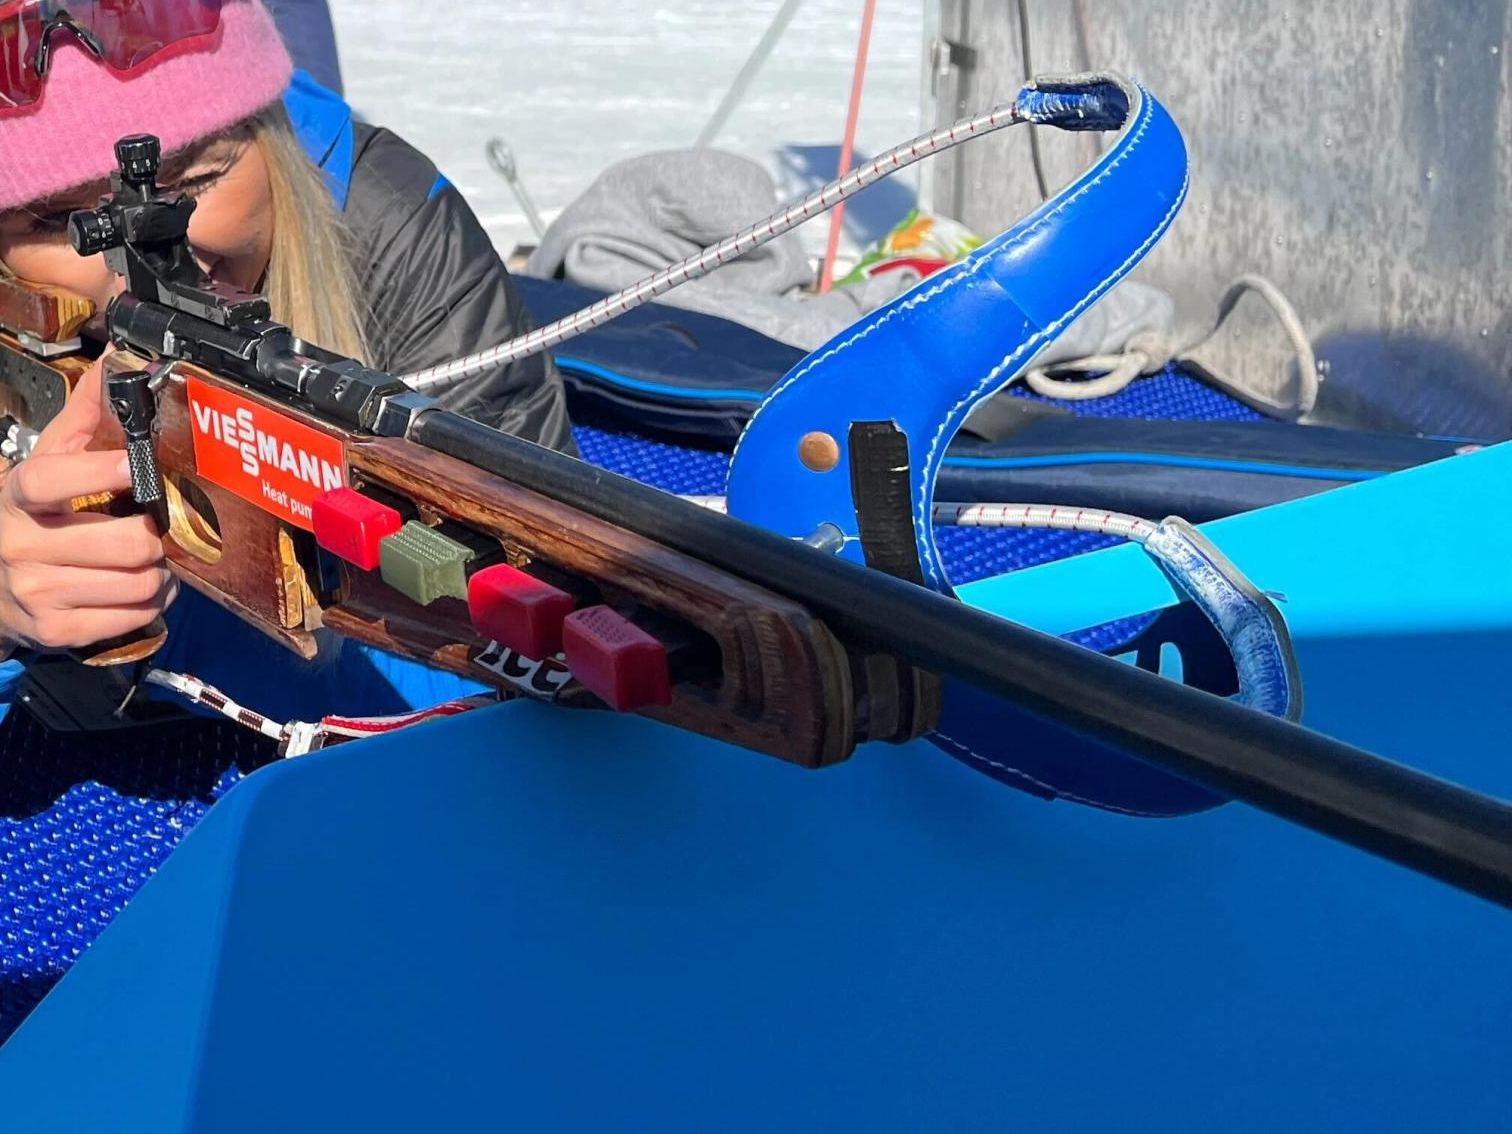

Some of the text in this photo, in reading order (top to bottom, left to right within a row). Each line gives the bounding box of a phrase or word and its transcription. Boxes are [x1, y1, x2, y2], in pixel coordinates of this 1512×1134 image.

[192, 399, 342, 492] VIESSMANN
[262, 479, 312, 520] Heat pum
